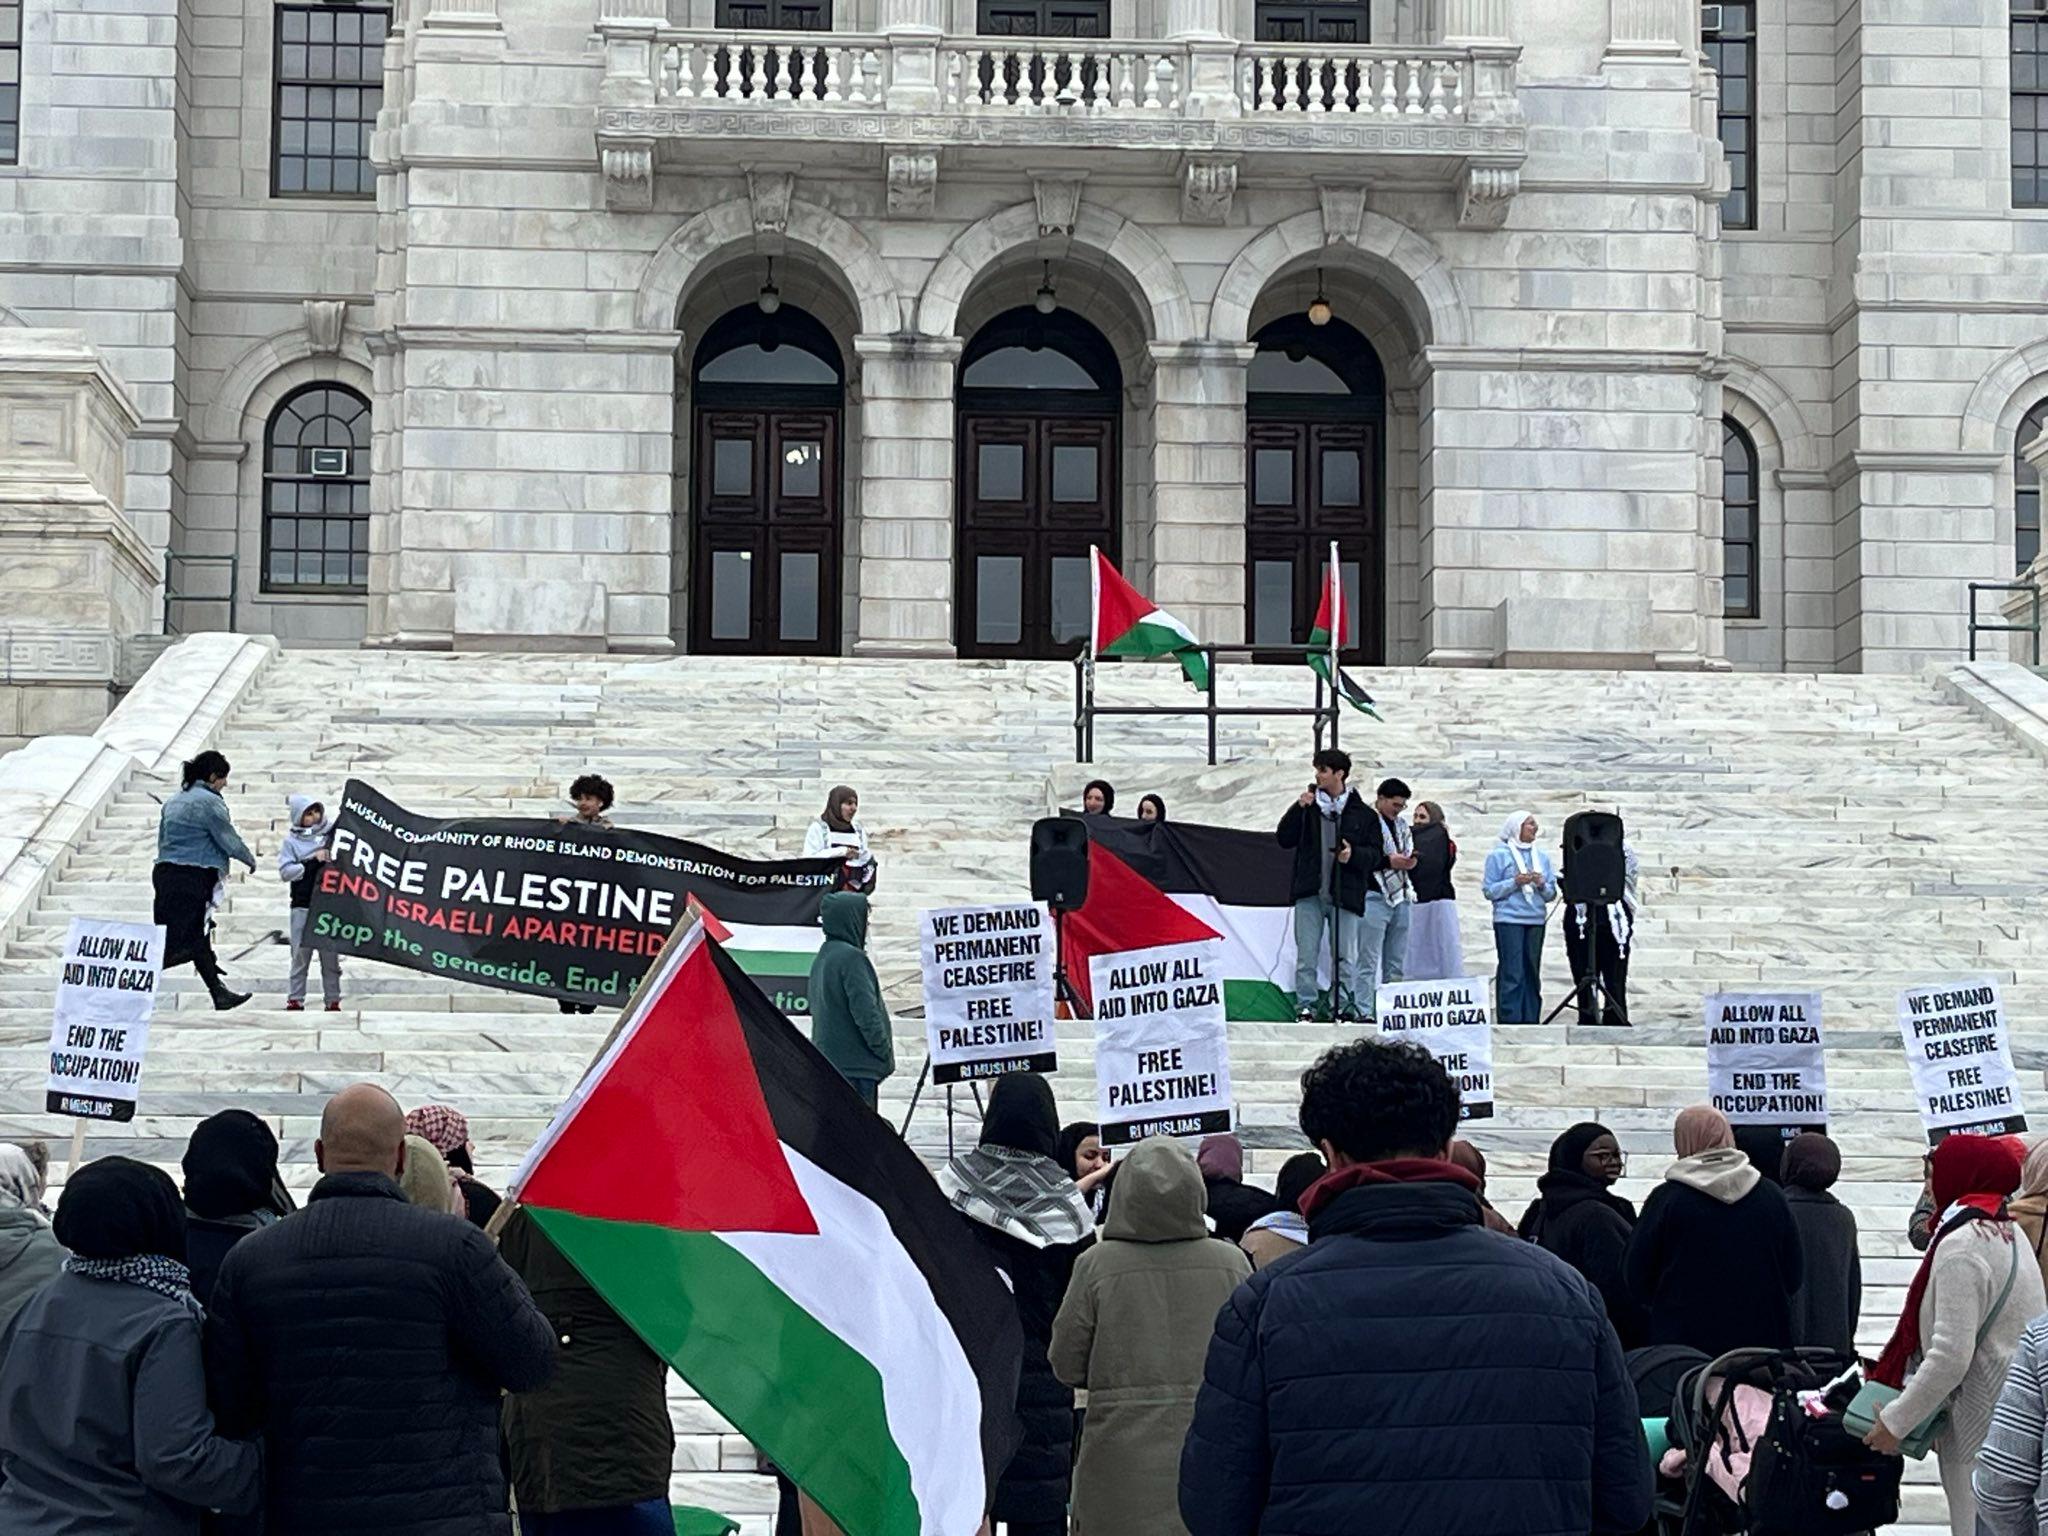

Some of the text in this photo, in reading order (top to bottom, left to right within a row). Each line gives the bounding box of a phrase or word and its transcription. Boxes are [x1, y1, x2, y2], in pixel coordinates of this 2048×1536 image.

[346, 798, 393, 833] MUSLIM
[394, 827, 480, 847] COMMUNITY
[482, 834, 502, 847] OF
[505, 836, 555, 852] RHODE
[558, 841, 612, 860] ISLAND
[615, 848, 735, 880] DEMONSTRATION
[738, 874, 766, 885] FOR
[330, 828, 675, 926] FREE PALESTINE
[320, 869, 666, 956] END ISRAELI APARTHEID
[932, 908, 1040, 937] WE DEMAND
[77, 936, 149, 962] ALLOW ALL
[314, 912, 374, 947] Stop
[383, 928, 423, 957] the
[432, 951, 556, 988] genocide.
[565, 966, 619, 995] End
[934, 934, 1042, 964] PERMANENT
[63, 963, 154, 993] AID INTO GAZA
[944, 961, 1036, 988] CEASEFIRE
[1109, 957, 1203, 990] ALLOW ALL
[967, 997, 1013, 1020] FREE
[1098, 983, 1219, 1020] AID INTO GAZA
[1393, 989, 1473, 1010] ALLOW ALL
[1908, 986, 1994, 1015] WE DEMAND
[1382, 1009, 1486, 1032] AID INTO GAZA
[1722, 1005, 1806, 1022] ALLOW ALL
[1912, 1009, 1998, 1038] PERMANENT
[67, 1025, 127, 1052] END THE
[940, 1020, 1043, 1050] PALESTINE!
[1710, 1027, 1819, 1044] AID INTO GAZA
[1924, 1033, 1998, 1061] CEASEFIRE
[50, 1052, 140, 1084] OCCUPATION!
[974, 1059, 1031, 1076] MUSLIMS
[1138, 1048, 1183, 1075] FREE
[1438, 1053, 1468, 1071] THE
[1109, 1073, 1217, 1107] PALESTINE!
[1733, 1073, 1801, 1090] END THE
[1947, 1066, 1983, 1088] FREE
[69, 1098, 113, 1116] MUSLIMS
[1712, 1095, 1823, 1113] OCCUPATION!
[1928, 1086, 2012, 1115] PALESTINE!
[1129, 1118, 1201, 1138] RI MUSLIMS
